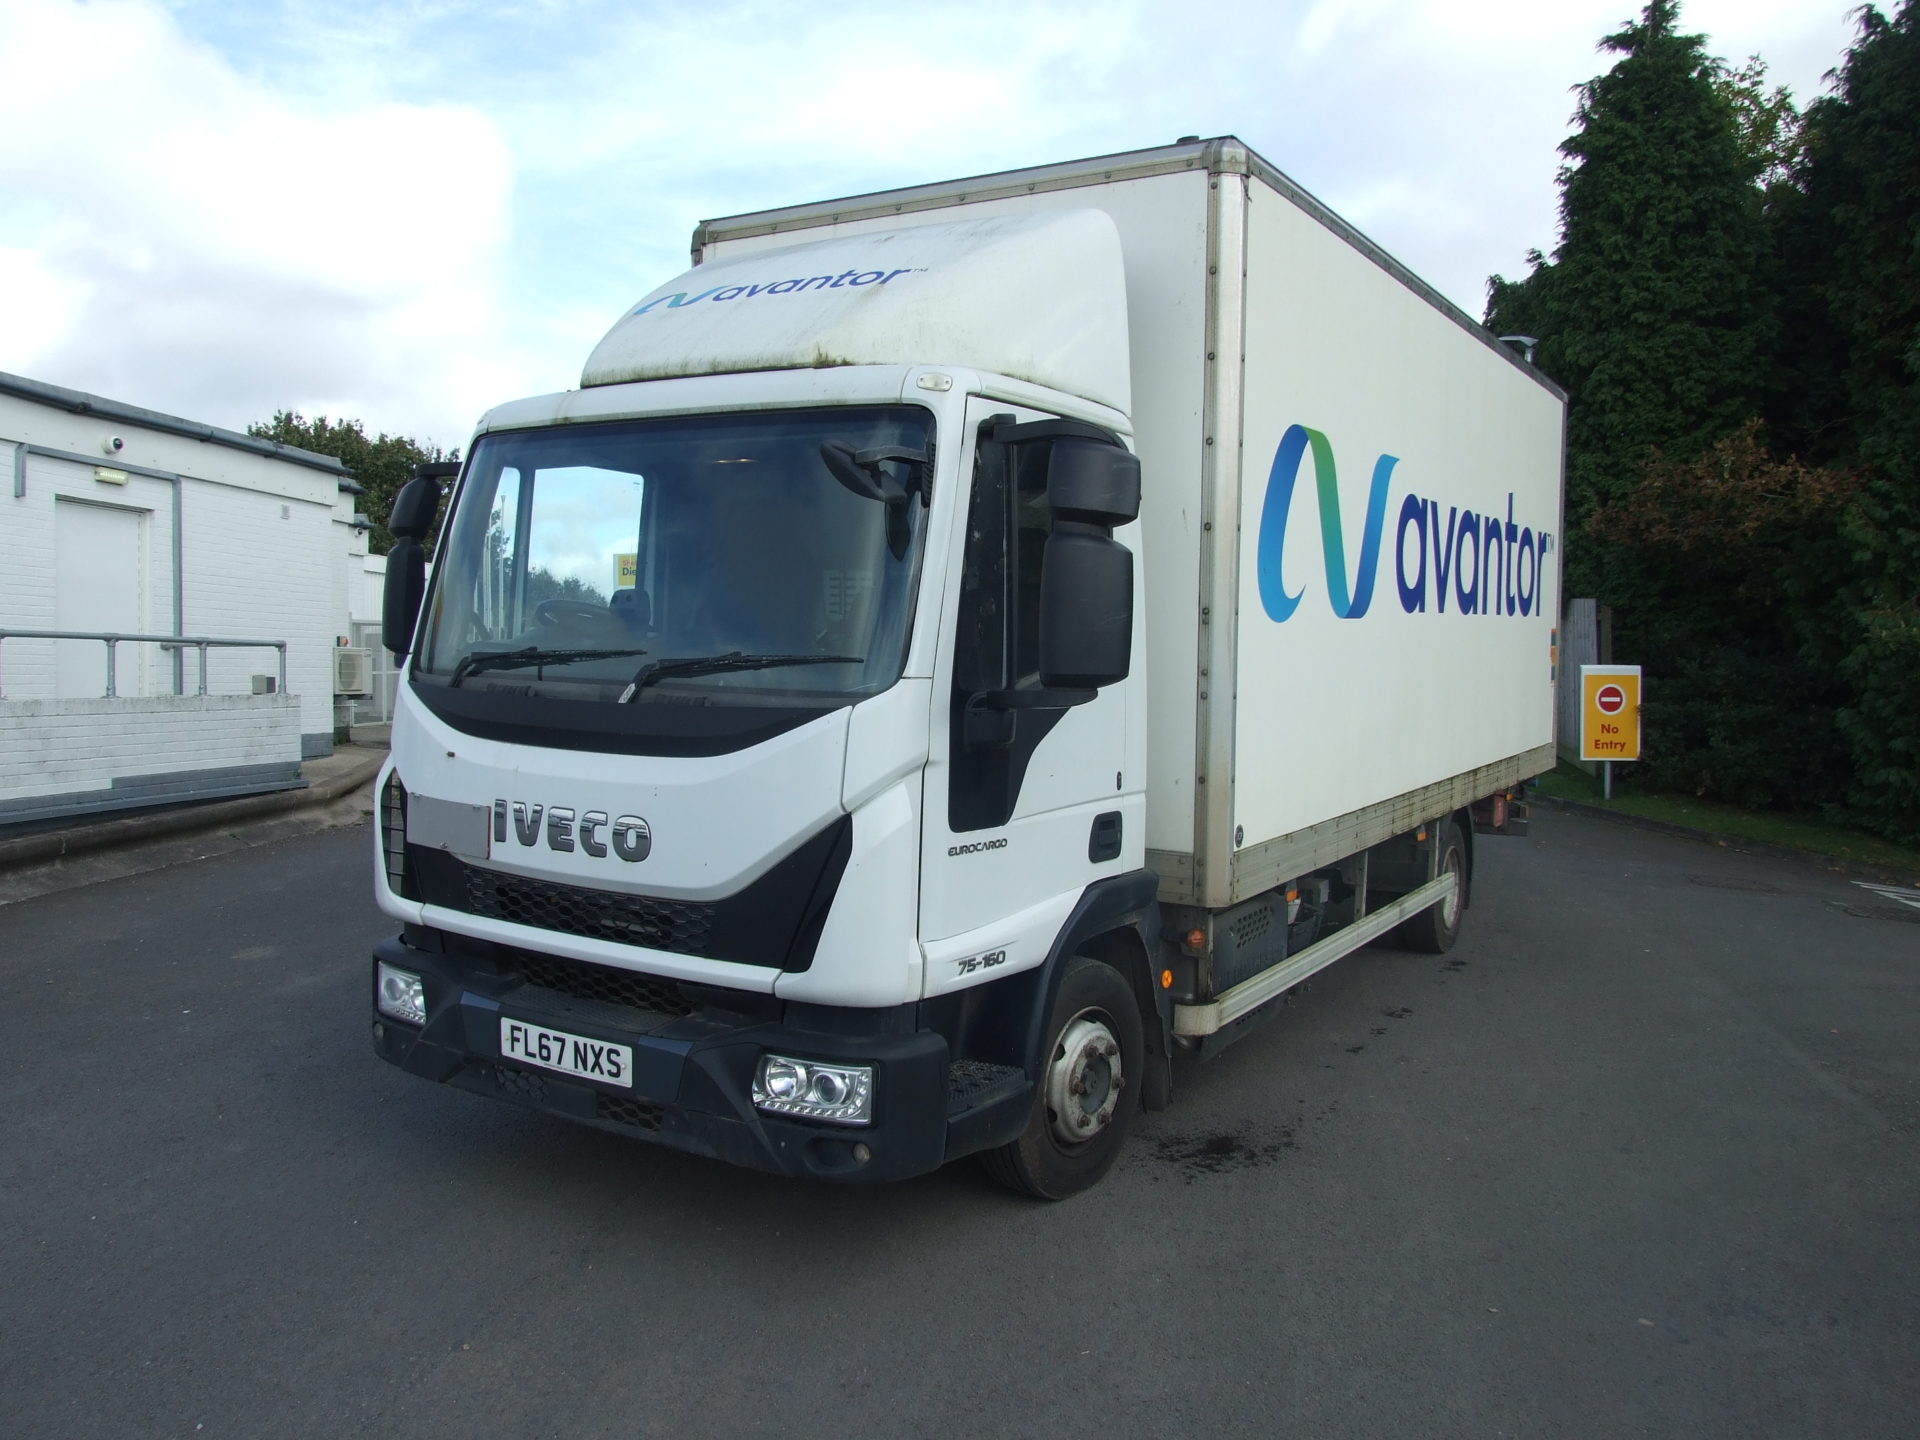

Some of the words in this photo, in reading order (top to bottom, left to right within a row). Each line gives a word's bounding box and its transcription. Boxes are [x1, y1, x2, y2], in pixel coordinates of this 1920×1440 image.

[712, 268, 911, 301] avantor
[1396, 492, 1547, 617] avantor
[1601, 724, 1619, 734] No
[1594, 740, 1626, 752] Entry
[494, 798, 652, 862] IVECO
[948, 838, 1008, 857] EUROCARGO
[958, 950, 1006, 976] 75-160
[510, 1024, 566, 1065] FL67
[573, 1040, 621, 1079] NXS
